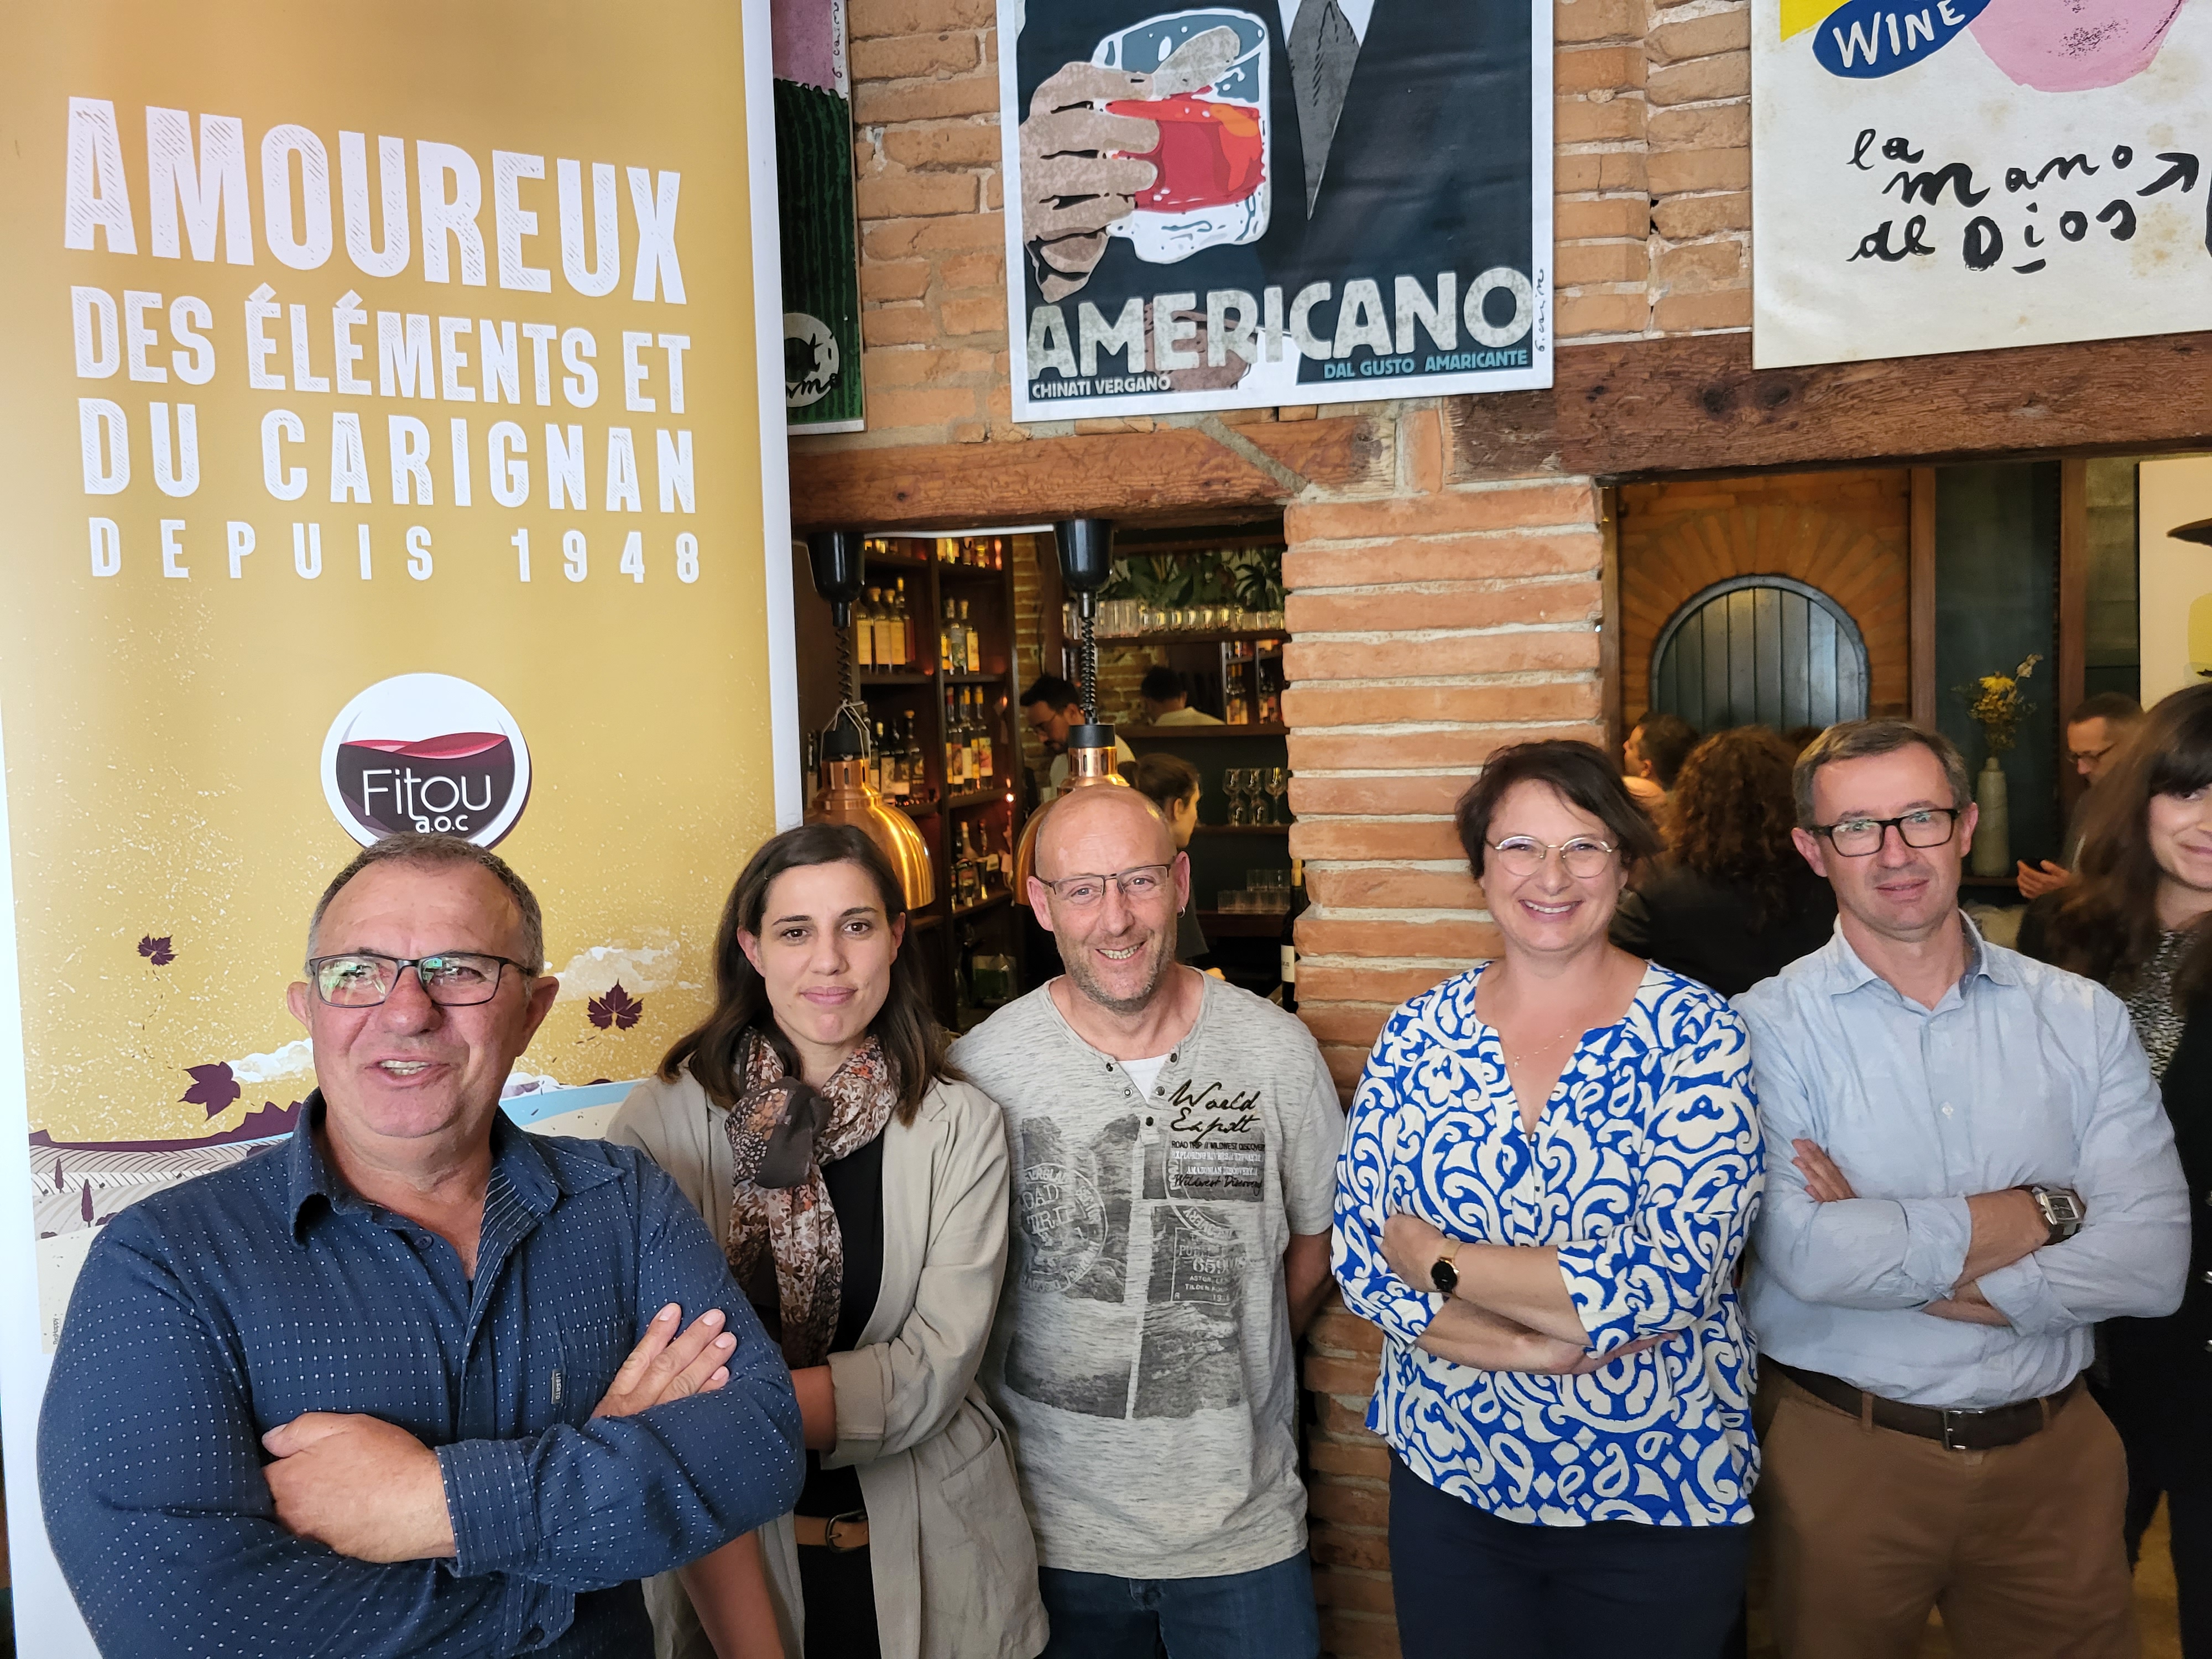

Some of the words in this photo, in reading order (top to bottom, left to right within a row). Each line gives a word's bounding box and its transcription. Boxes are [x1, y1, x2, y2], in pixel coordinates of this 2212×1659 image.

[1832, 0, 1965, 68] WINE
[1846, 128, 1924, 170] la
[65, 96, 687, 305] AMOUREUX
[1846, 215, 1936, 262] de
[1962, 199, 2137, 274] Dios
[70, 284, 216, 386] DES
[244, 282, 599, 408] ÉLÉMENTS
[623, 331, 691, 414] ET
[1027, 267, 1533, 378] AMERICANO
[1032, 380, 1092, 398] CHINATI
[1094, 375, 1171, 394] VERGANO
[1324, 363, 1355, 379] DAL
[1360, 358, 1415, 376] GUSTO
[1425, 349, 1527, 372] AMARICANTE
[77, 398, 200, 498] DU
[260, 409, 696, 513] CARIGNAN
[89, 517, 434, 581] DEPUIS
[511, 528, 700, 584] 1948
[362, 768, 492, 816] Fitou
[1171, 1140, 1188, 1149] ROAD
